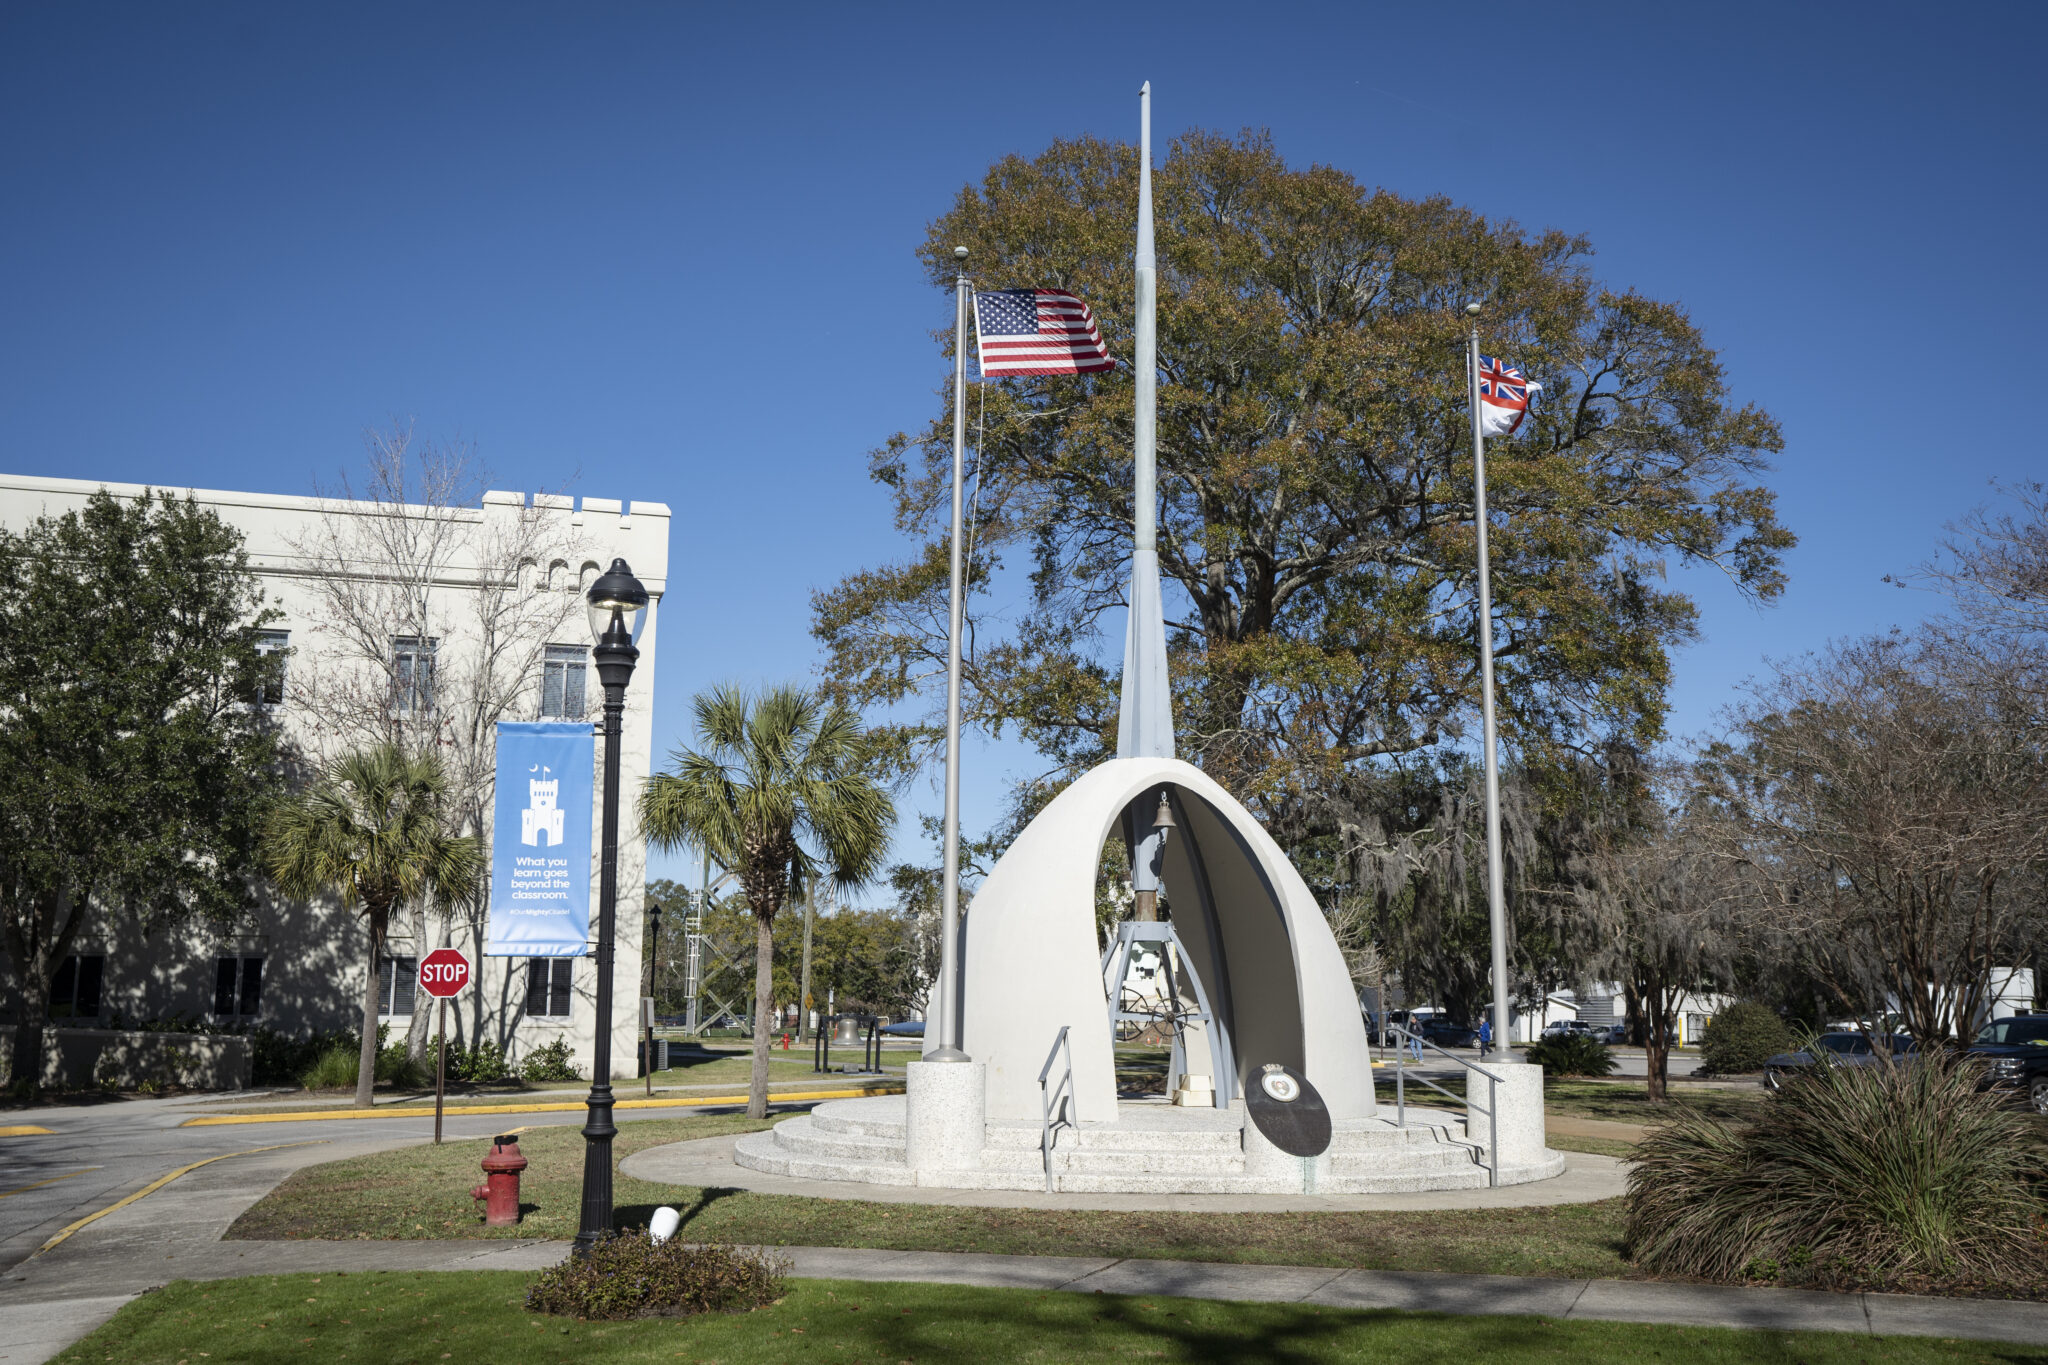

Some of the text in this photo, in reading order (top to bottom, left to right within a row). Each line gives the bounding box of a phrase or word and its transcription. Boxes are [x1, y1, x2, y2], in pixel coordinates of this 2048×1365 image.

[516, 857, 567, 868] What you
[513, 868, 568, 879] learn goes
[511, 879, 570, 890] beyond the
[512, 890, 568, 899] classroom.
[423, 964, 466, 982] STOP
